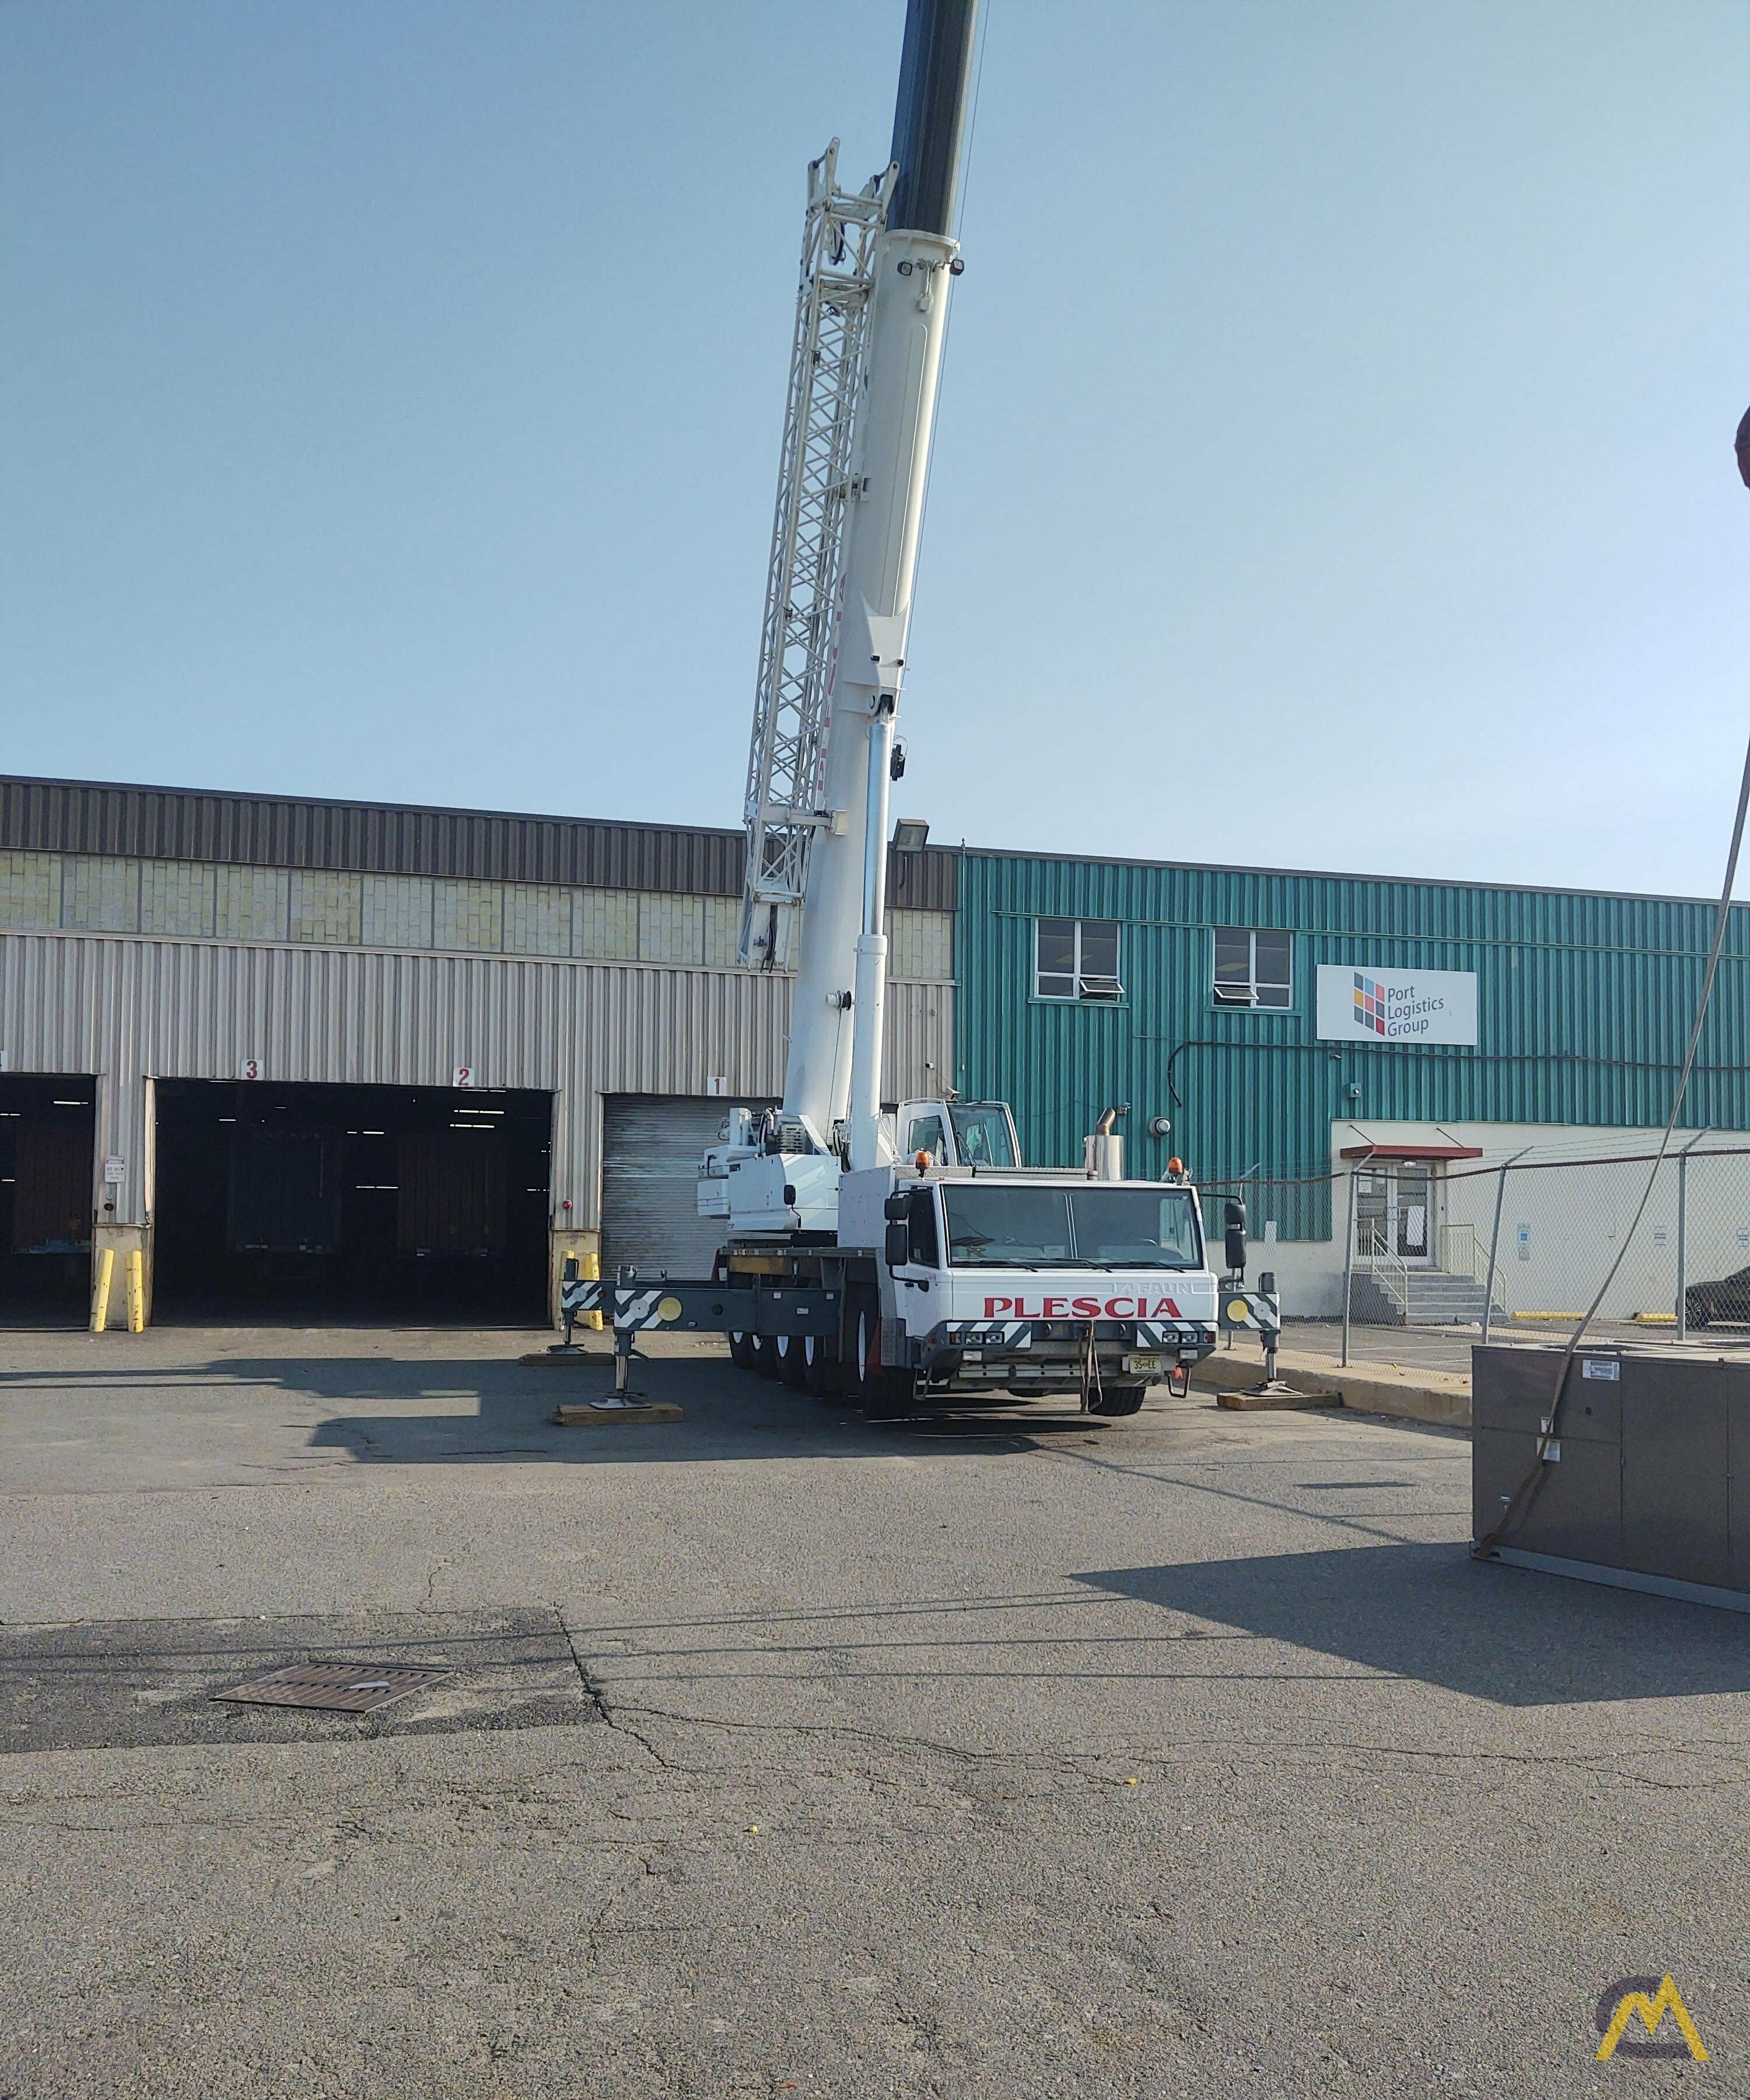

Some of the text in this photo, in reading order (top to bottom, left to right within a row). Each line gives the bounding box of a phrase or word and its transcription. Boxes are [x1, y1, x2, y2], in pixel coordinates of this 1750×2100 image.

[1387, 985, 1415, 1003] Port
[1387, 997, 1444, 1021] Logistics
[1387, 1017, 1429, 1037] Group
[246, 1060, 257, 1079] 3
[459, 1068, 470, 1086] 2
[715, 1079, 720, 1095] 1
[1138, 1283, 1192, 1294] FAUN
[984, 1297, 1183, 1318] PLESCIA
